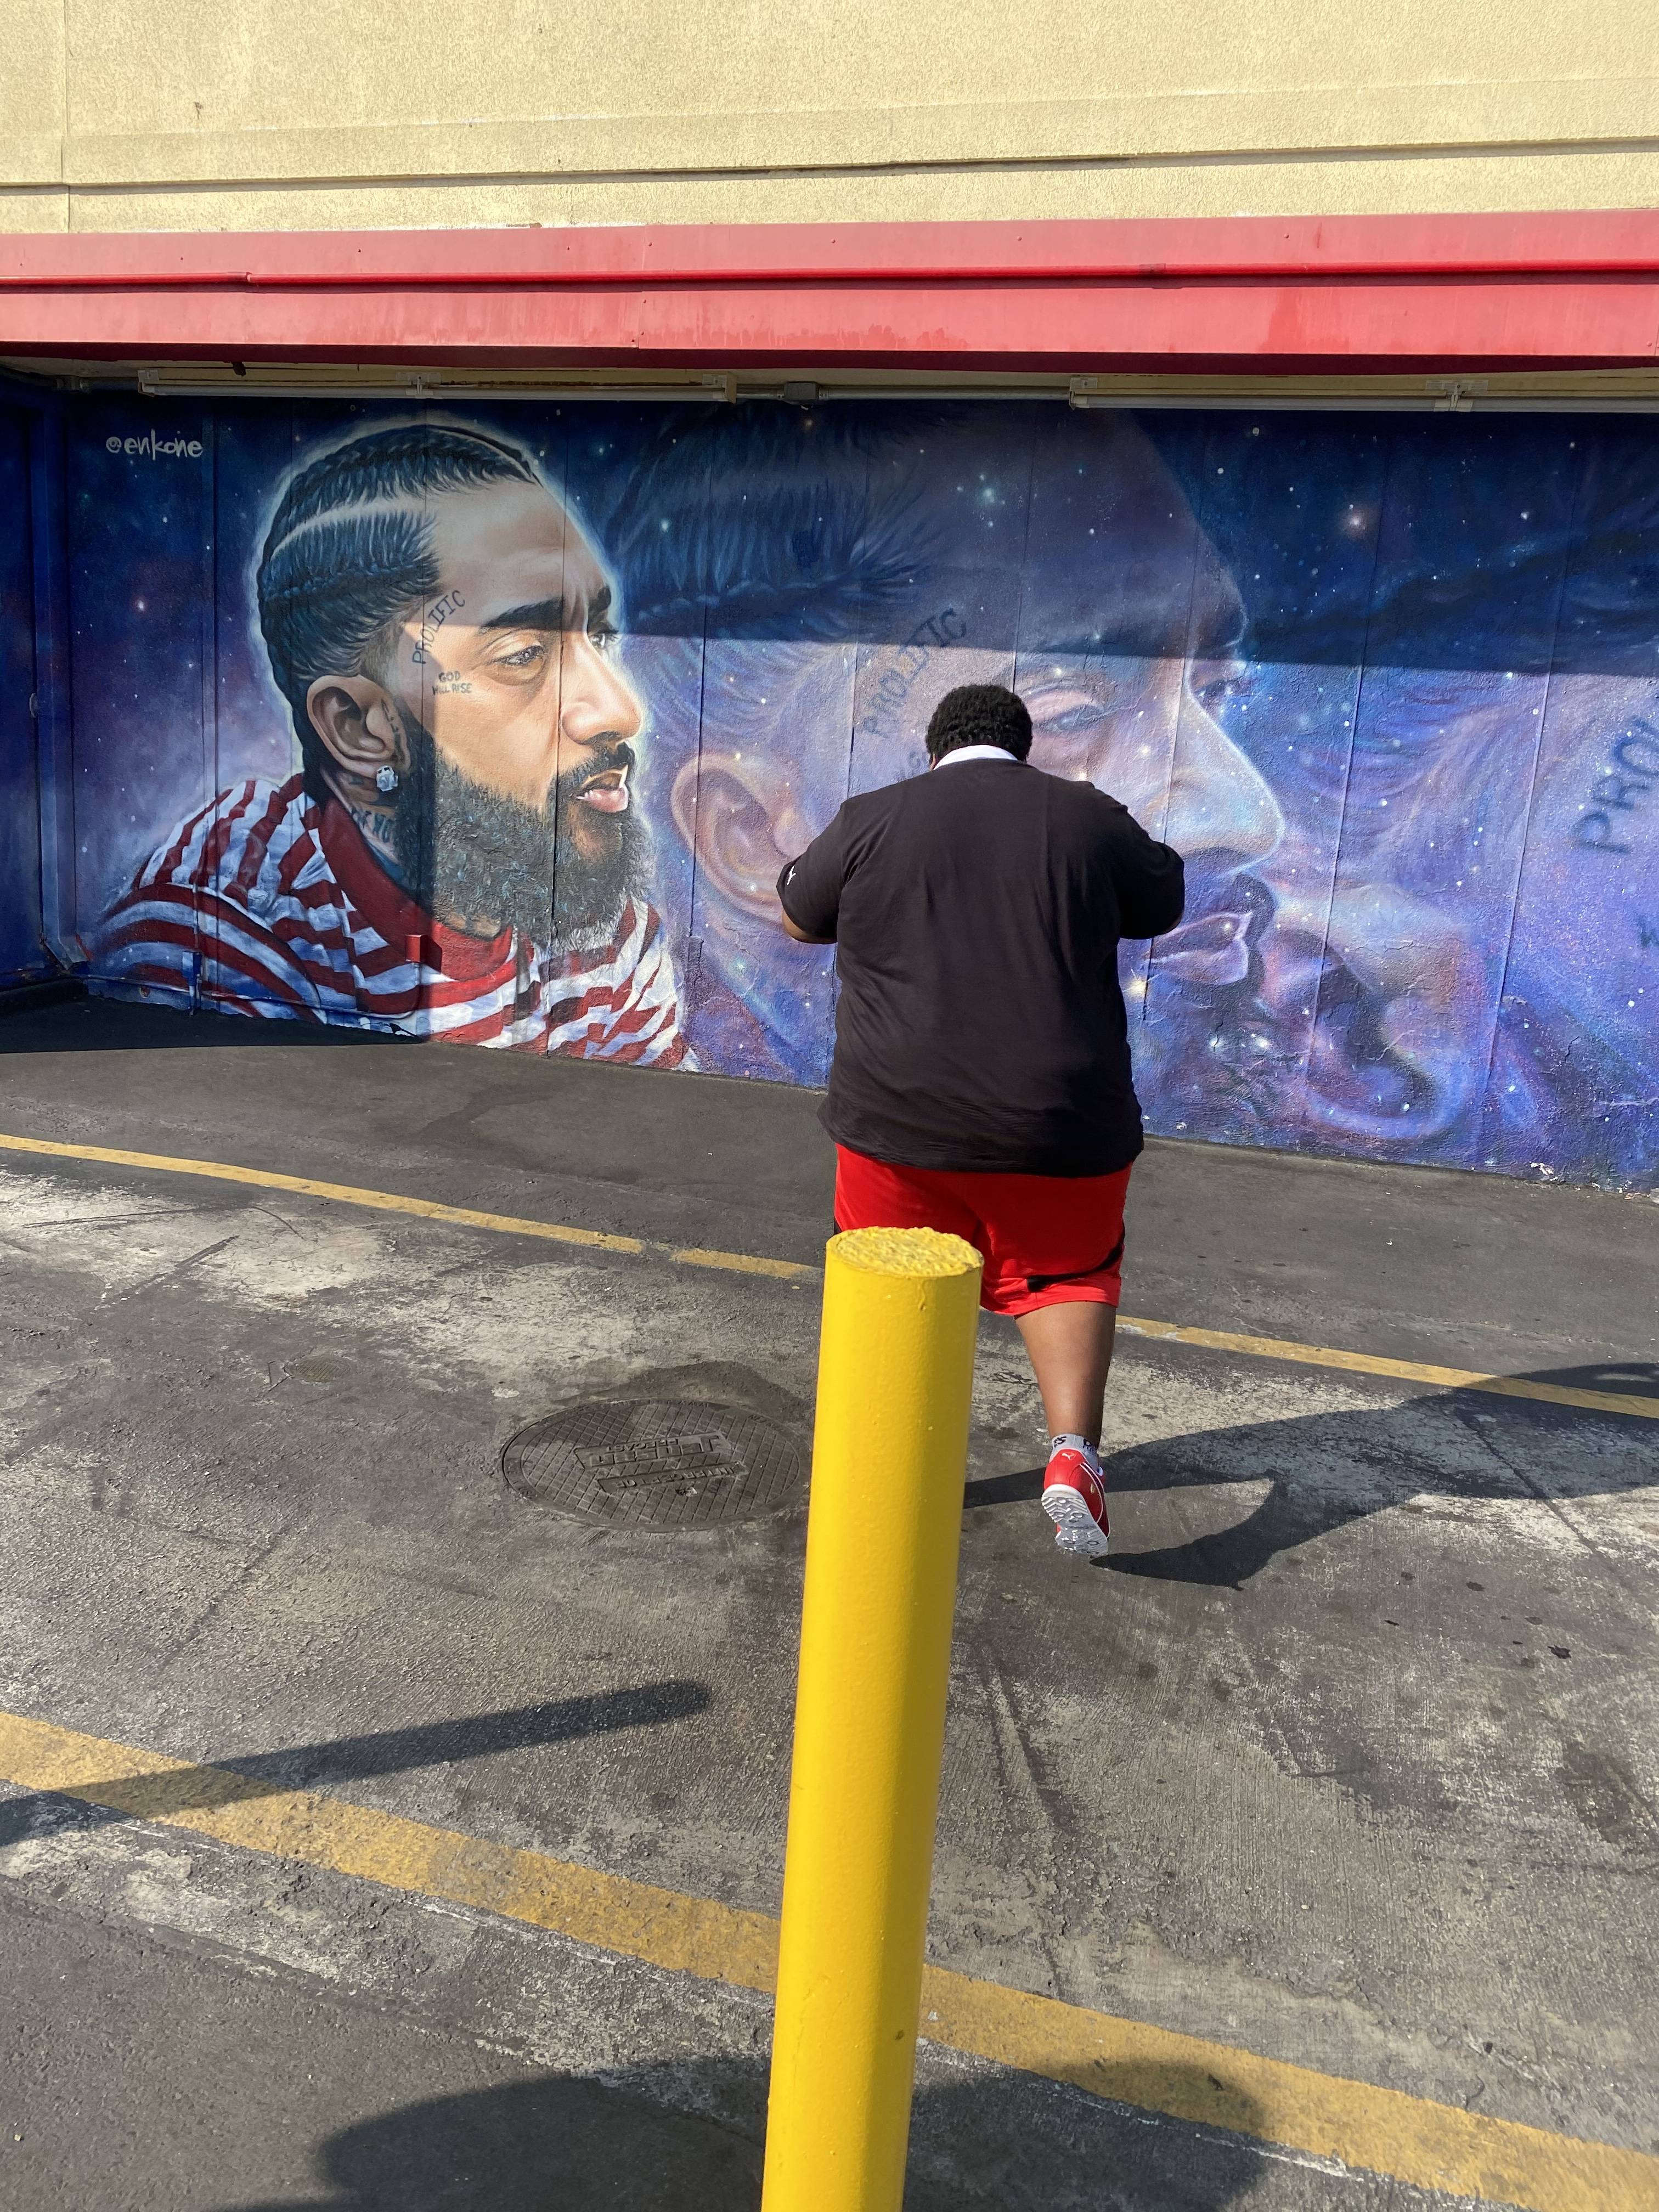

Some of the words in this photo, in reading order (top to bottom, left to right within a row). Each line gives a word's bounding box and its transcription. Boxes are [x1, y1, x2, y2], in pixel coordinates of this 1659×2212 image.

[106, 428, 204, 461] @enkone
[412, 590, 465, 665] PROLIFIC
[438, 670, 461, 682] GOD
[452, 682, 472, 694] RISE
